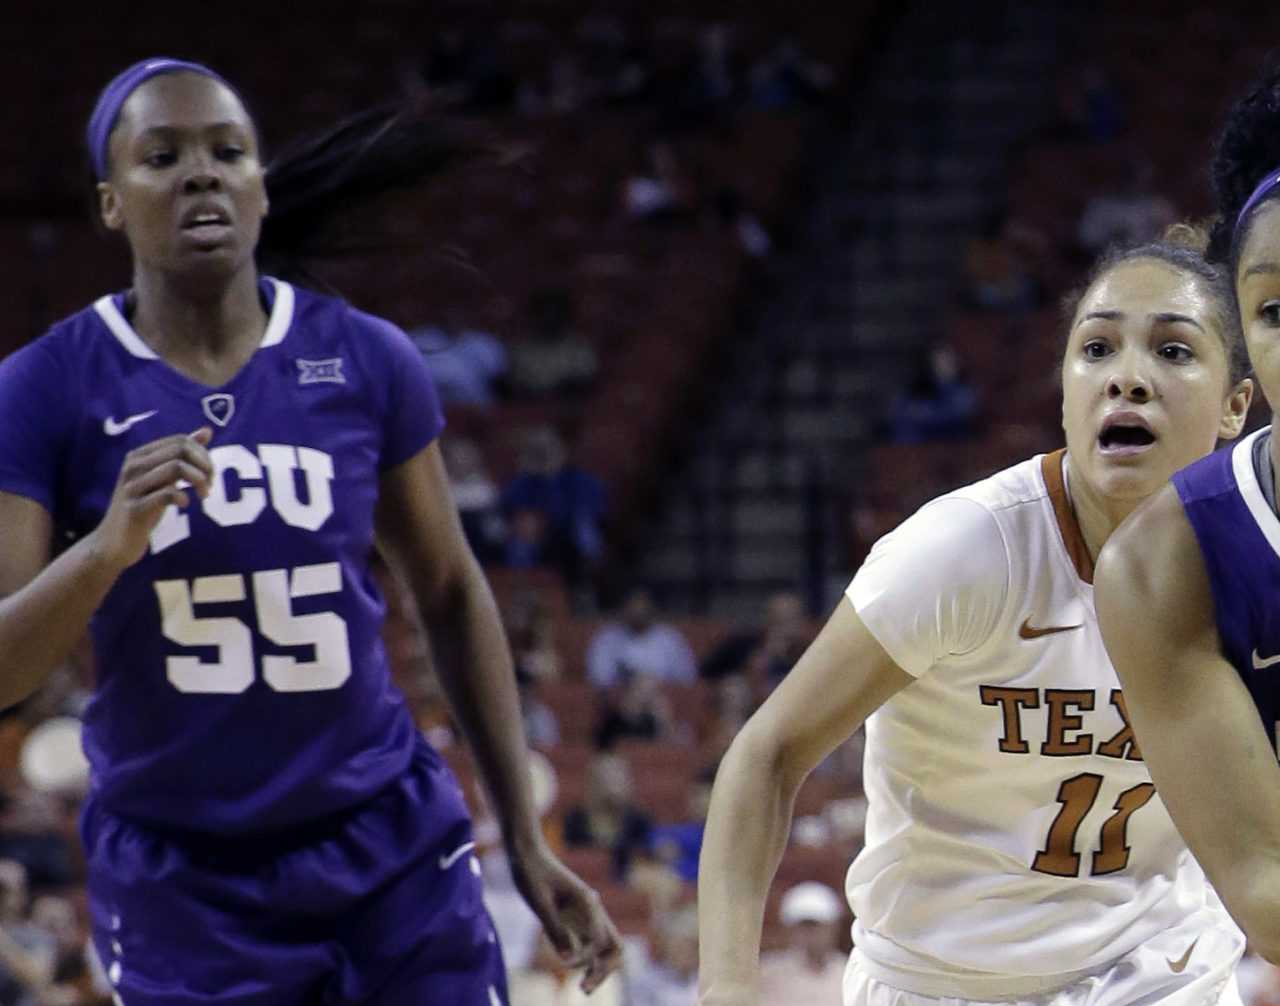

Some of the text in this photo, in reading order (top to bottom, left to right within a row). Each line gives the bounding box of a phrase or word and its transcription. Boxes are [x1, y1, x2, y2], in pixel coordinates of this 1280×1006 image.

[150, 443, 335, 556] CU
[153, 561, 352, 695] 55
[1031, 772, 1156, 878] 11
